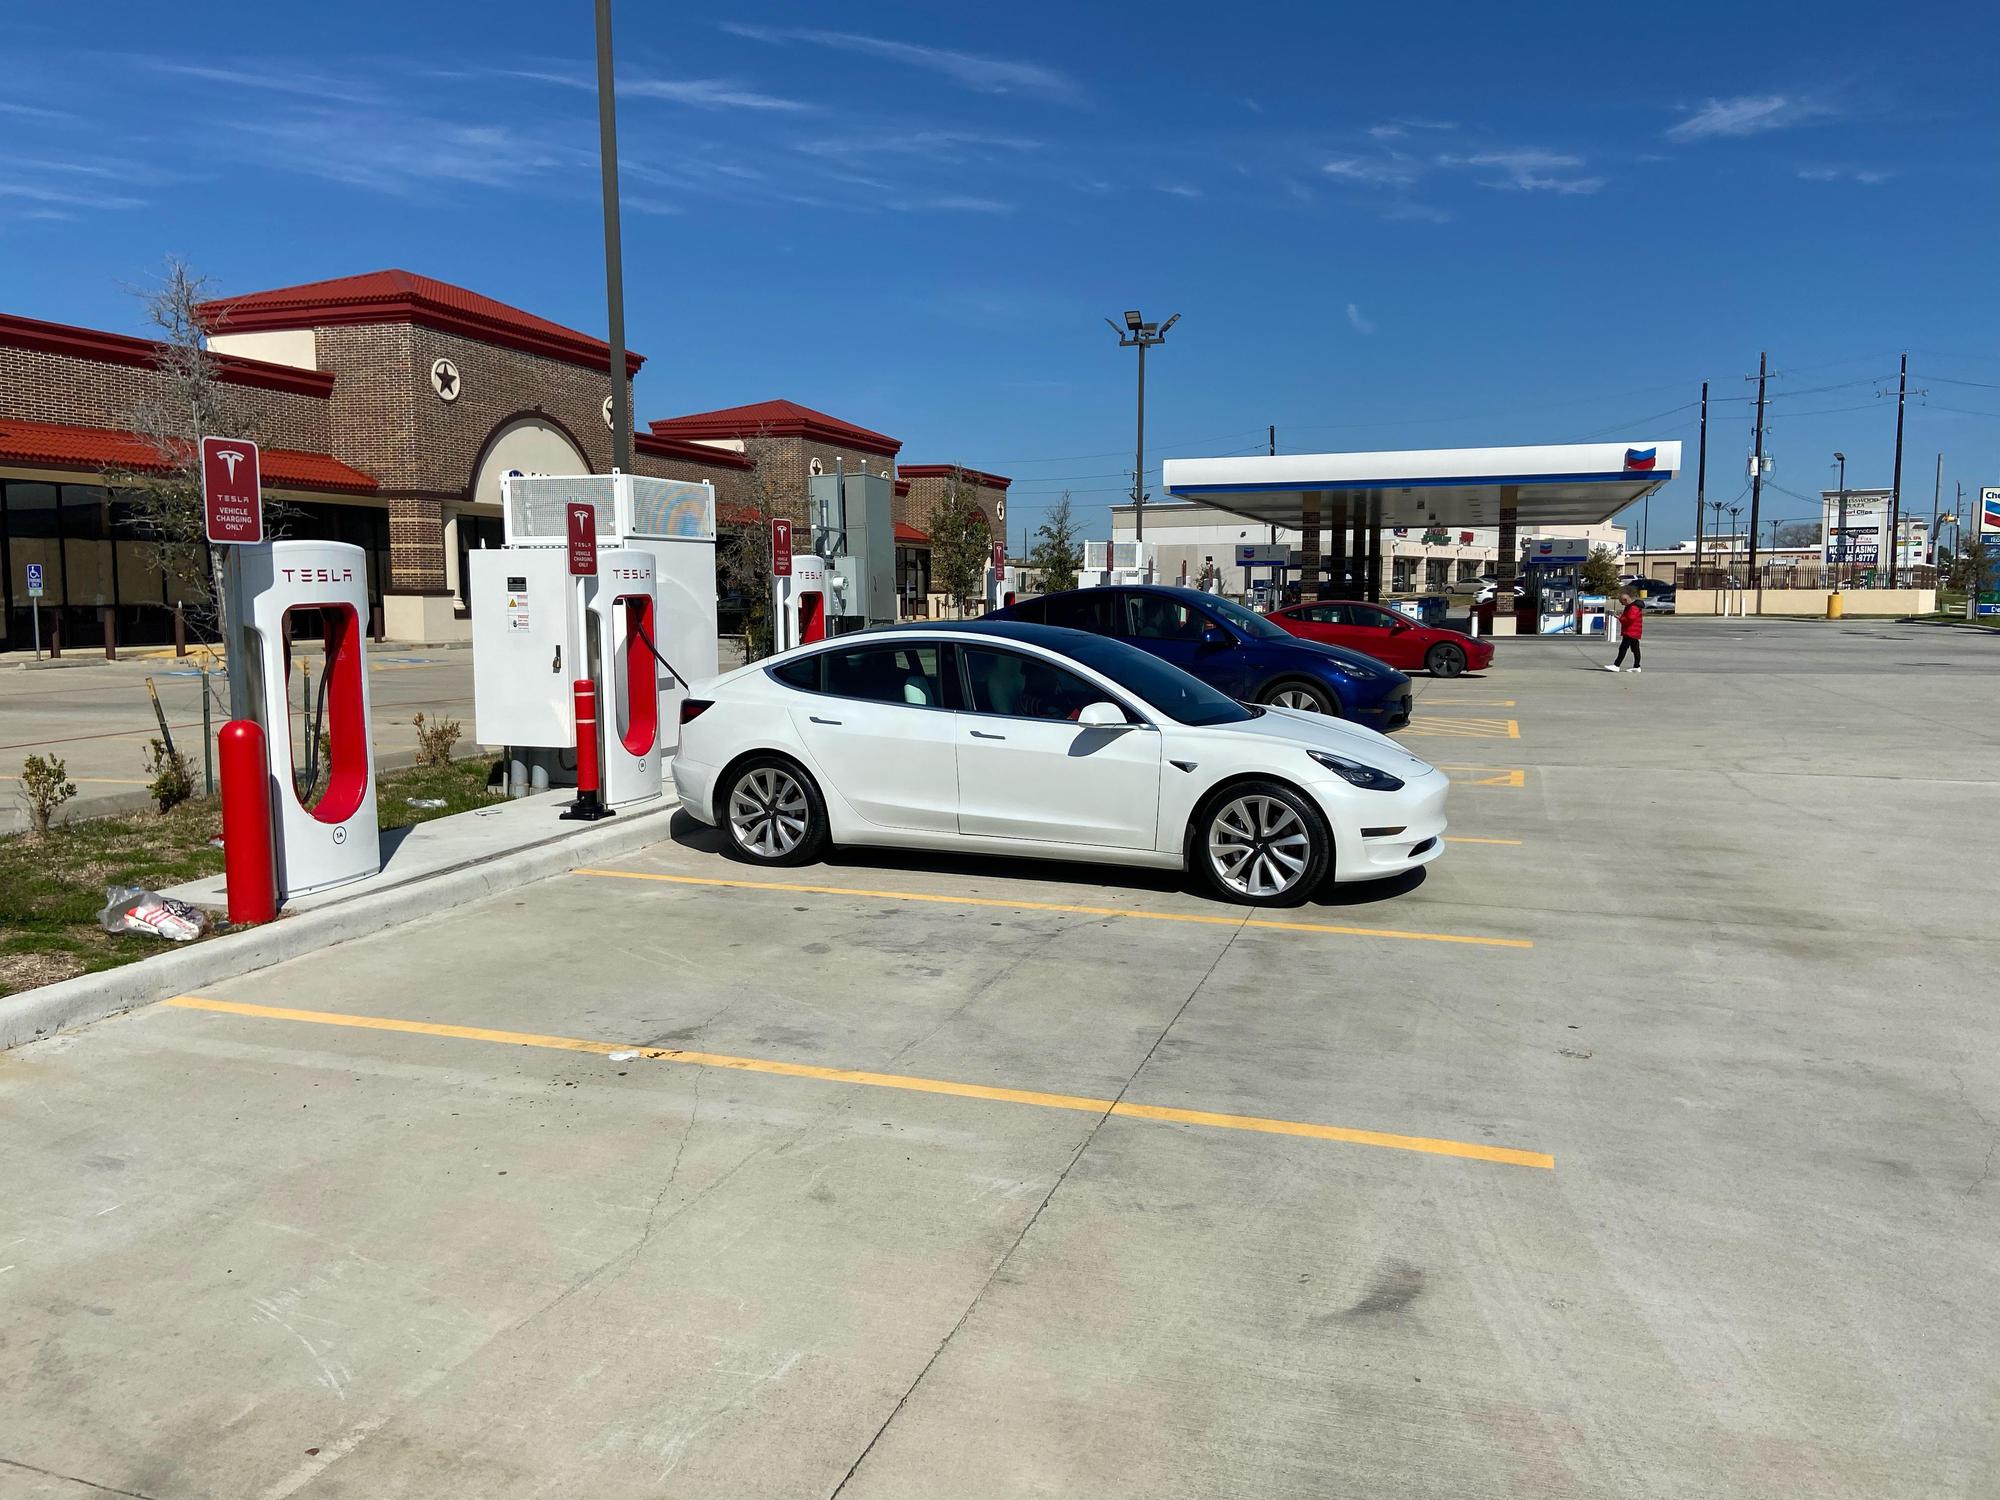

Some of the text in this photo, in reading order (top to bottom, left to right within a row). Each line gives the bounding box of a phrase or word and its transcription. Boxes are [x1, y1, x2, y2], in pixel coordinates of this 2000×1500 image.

[217, 494, 250, 503] TESLA
[219, 507, 248, 515] VEHICLE
[216, 514, 252, 524] CHARGING
[225, 523, 244, 531] ONLY
[281, 569, 352, 583] TESLA
[612, 569, 651, 579] TESLA
[798, 571, 822, 580] TESLA
